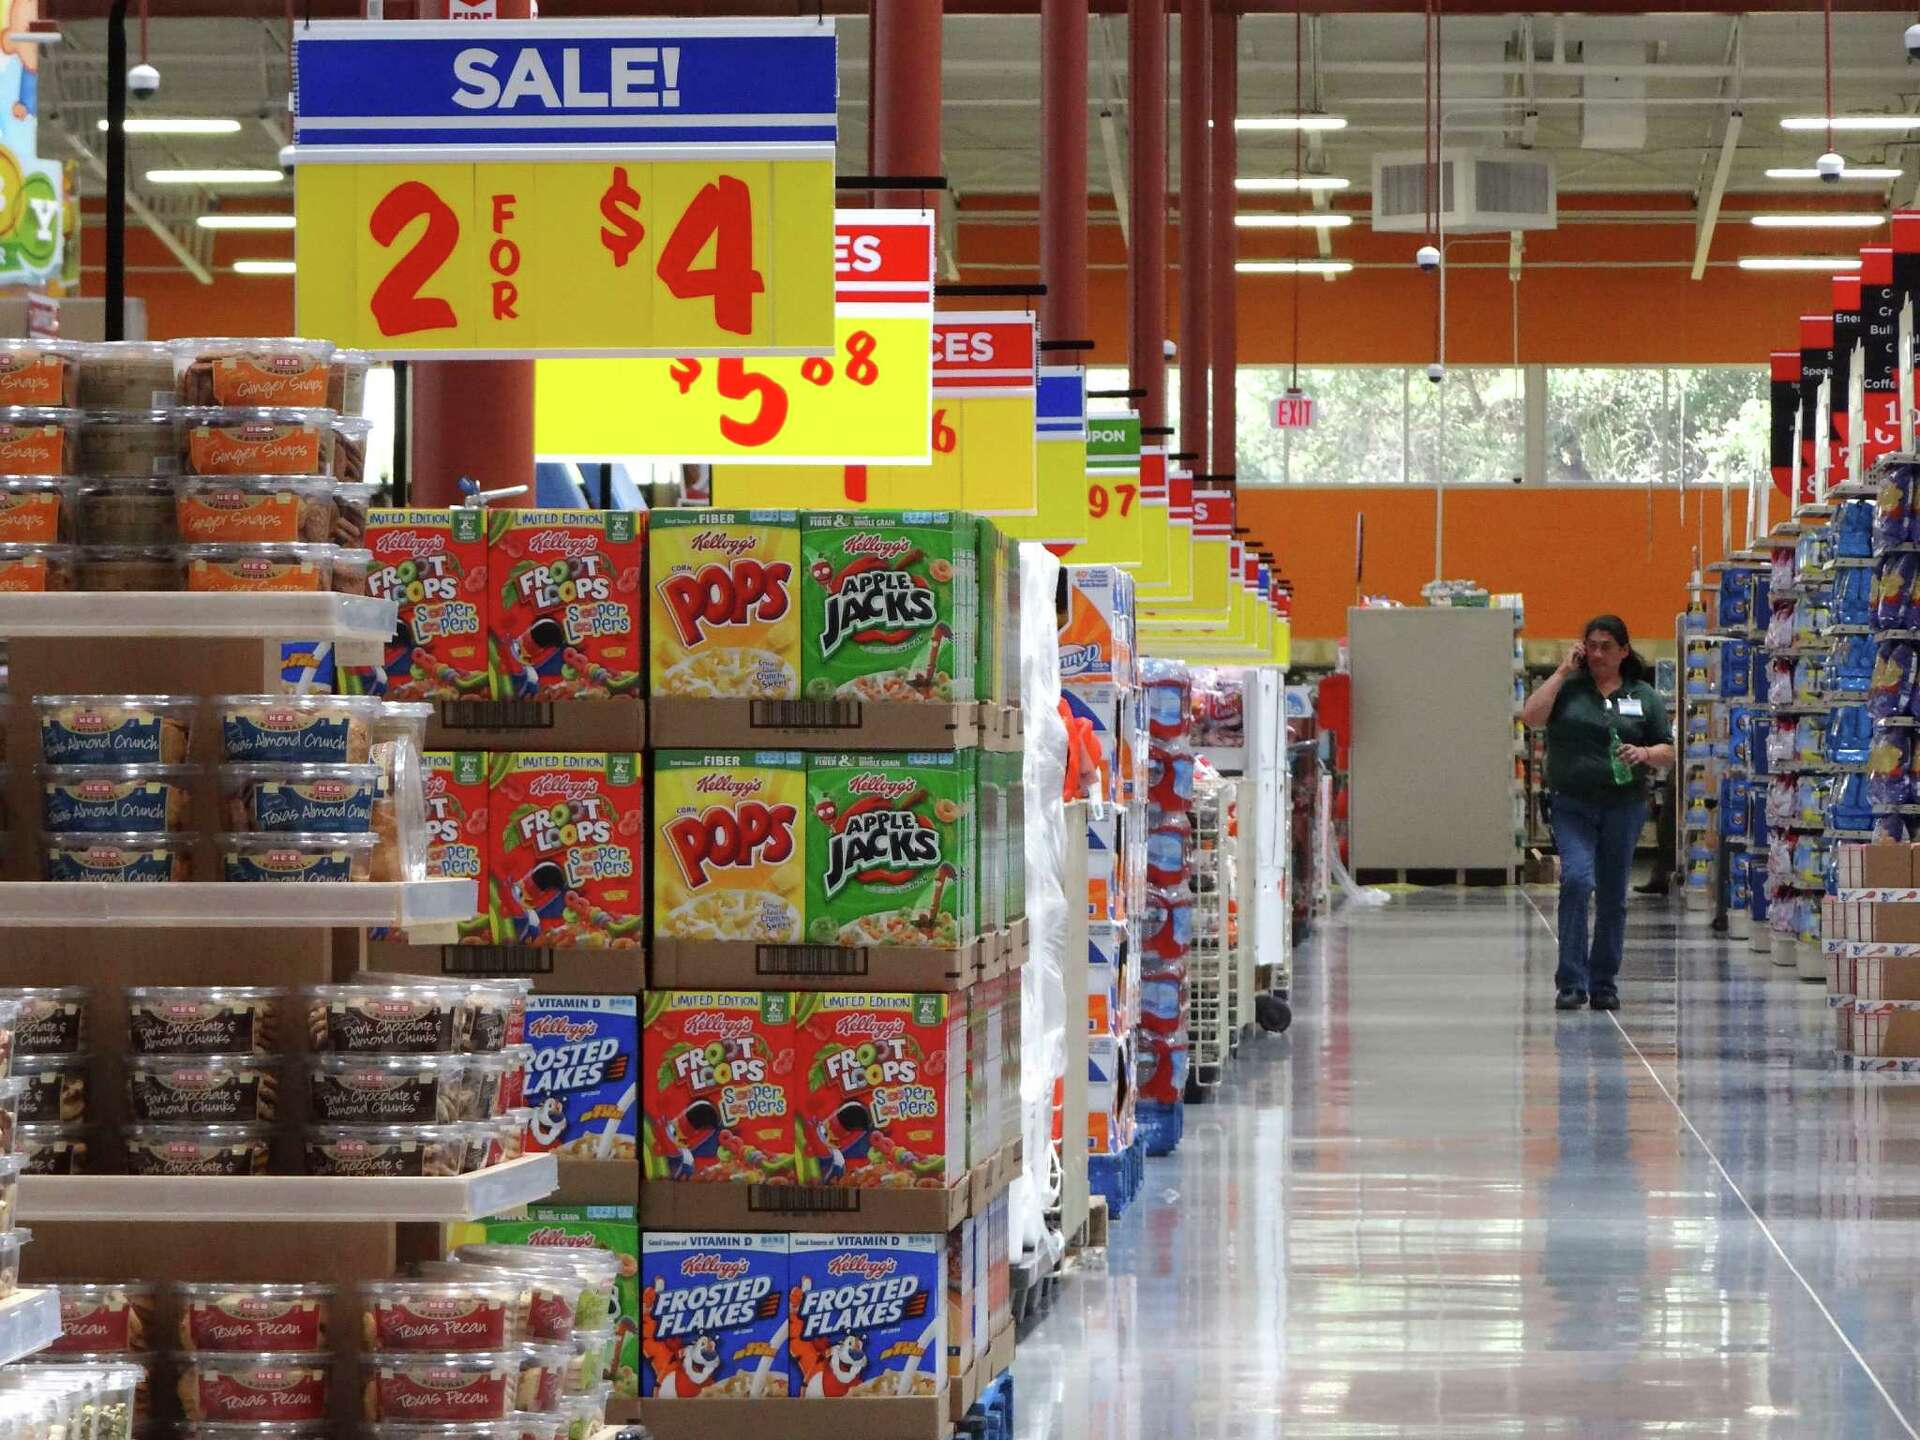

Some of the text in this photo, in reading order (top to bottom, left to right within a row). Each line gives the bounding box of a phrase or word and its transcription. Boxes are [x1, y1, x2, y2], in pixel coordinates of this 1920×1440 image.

[451, 46, 681, 109] SALE!
[369, 180, 460, 337] 2
[237, 382, 287, 399] Ginger
[1278, 400, 1312, 427] EXIT
[1086, 429, 1126, 443] UPON
[210, 443, 308, 466] Ginger Snaps
[1088, 484, 1137, 518] 97
[230, 511, 282, 530] Snaps
[370, 513, 450, 526] IMITED EDITION
[515, 513, 603, 527] LIMITED EDITION
[699, 513, 735, 525] FIBER
[377, 531, 444, 555] Kellogg's
[529, 531, 598, 556] Kellogg's
[692, 532, 757, 556] Kellogg's
[843, 532, 911, 559] Kellogg's
[840, 569, 912, 598] APPLE
[656, 558, 795, 651] POPS
[820, 588, 938, 659] JACKS
[68, 732, 159, 751] Almond Crunch
[255, 730, 301, 748] Almond
[303, 733, 347, 750] Crunch
[517, 754, 604, 769] LIMITED EDITION
[704, 755, 740, 767] FIBER
[531, 774, 598, 799] Kellogg's
[697, 774, 763, 797] Kellogg's
[849, 772, 917, 799] Kellogg's
[73, 802, 165, 818] Almond Crunch
[302, 801, 346, 818] Almond
[845, 810, 917, 837] APPLE
[661, 800, 799, 892] POPS
[824, 829, 943, 899] JACKS
[537, 997, 601, 1009] VITAMIN D
[671, 994, 758, 1007] LIMITED EDITION
[822, 995, 911, 1008] LIMITED EDITION
[166, 1020, 226, 1035] Chocolate
[344, 1020, 373, 1037] Dark
[375, 1019, 433, 1033] Chocolate
[529, 1014, 598, 1042] Kellogg's
[684, 1013, 752, 1039] Kellogg's
[836, 1013, 905, 1040] Kellogg's
[348, 1029, 438, 1048] Almond Chunks
[524, 1038, 619, 1073] ROSTED
[523, 1063, 604, 1097] LAKES
[171, 1088, 230, 1103] Chocolate
[327, 1104, 369, 1118] Almond
[528, 1228, 596, 1248] Kellogg's
[690, 1236, 739, 1247] VITAMIN
[744, 1236, 752, 1247] D
[837, 1236, 888, 1247] VITAMIN
[892, 1236, 900, 1247] D
[682, 1254, 750, 1279] Kellogg's
[828, 1254, 897, 1279] Kellogg's
[654, 1276, 772, 1317] FROSTED
[801, 1276, 918, 1317] FROSTED
[208, 1321, 302, 1340] Texas Pecan
[398, 1320, 488, 1339] Texas Pecan
[655, 1301, 756, 1339] FLAKES
[803, 1300, 903, 1338] FLAKES
[221, 1392, 312, 1410] Texas Pecan
[397, 1390, 490, 1409] Texas Pecan
